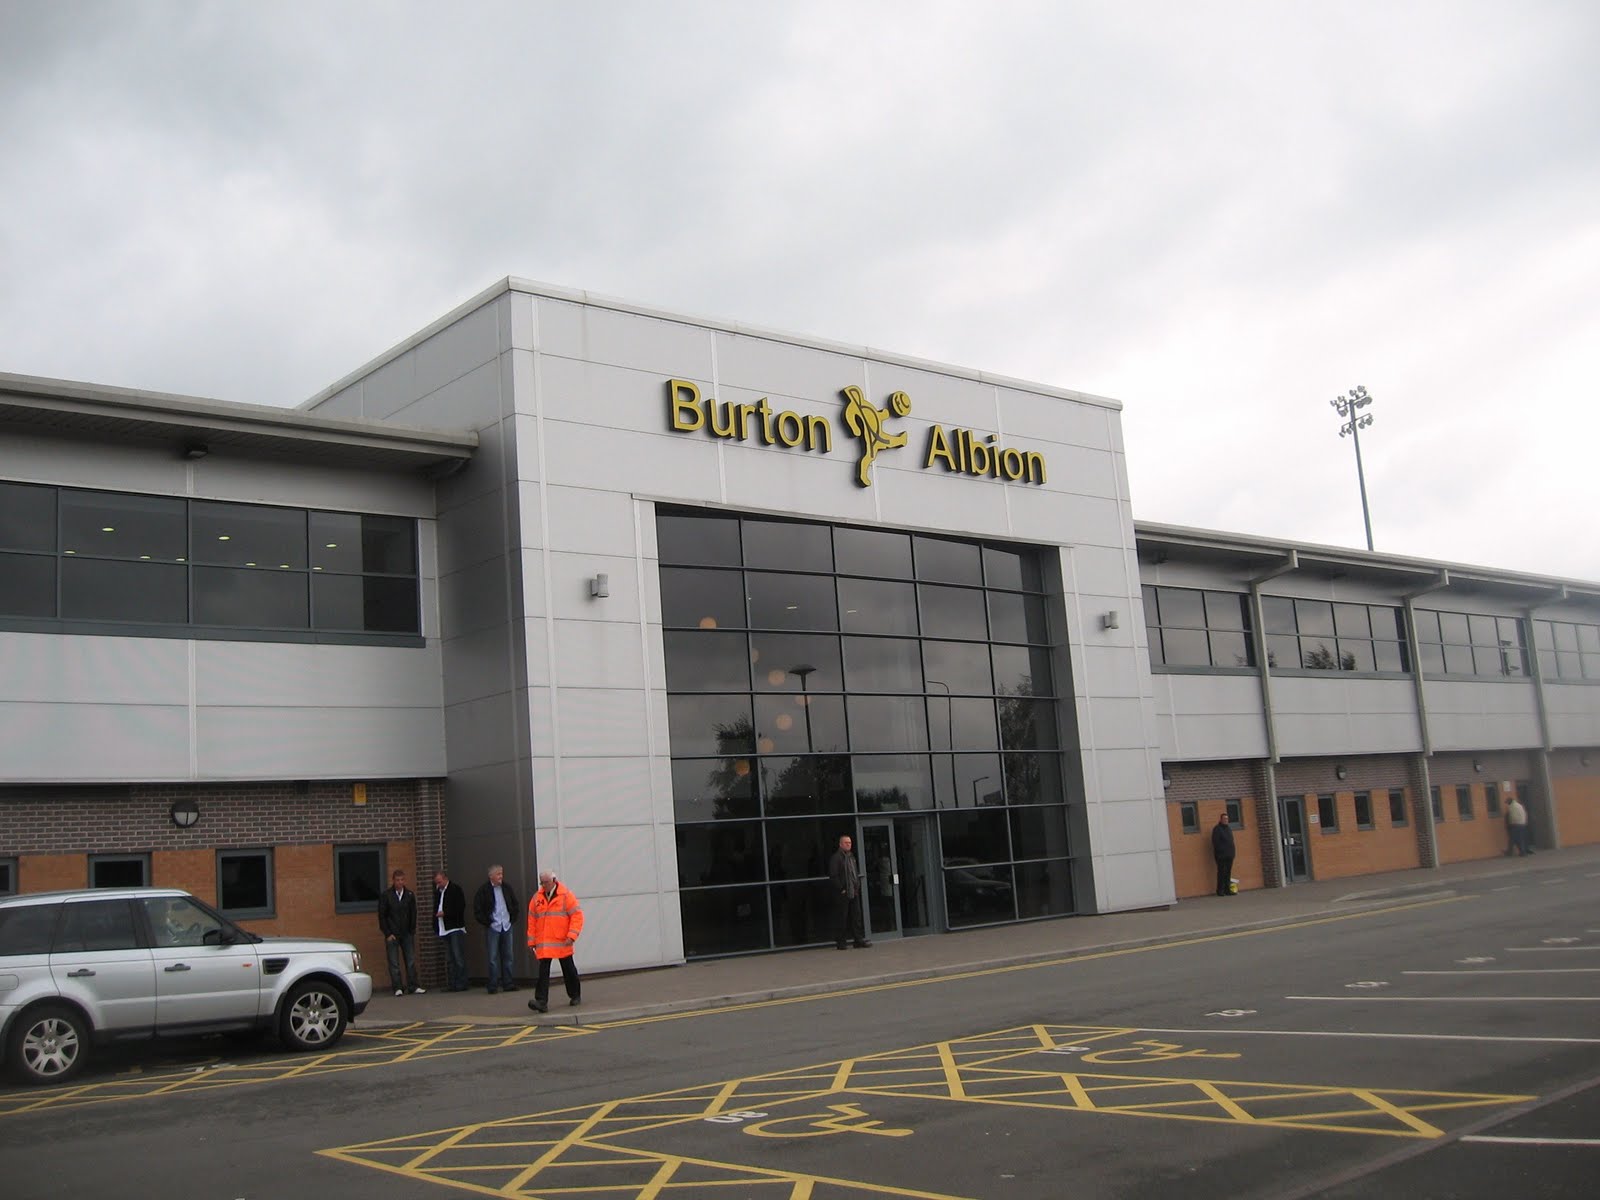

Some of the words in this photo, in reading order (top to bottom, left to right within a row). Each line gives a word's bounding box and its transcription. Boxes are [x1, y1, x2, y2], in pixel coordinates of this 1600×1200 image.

[666, 378, 832, 453] Burton
[923, 424, 1047, 484] Albion
[894, 394, 910, 413] FC
